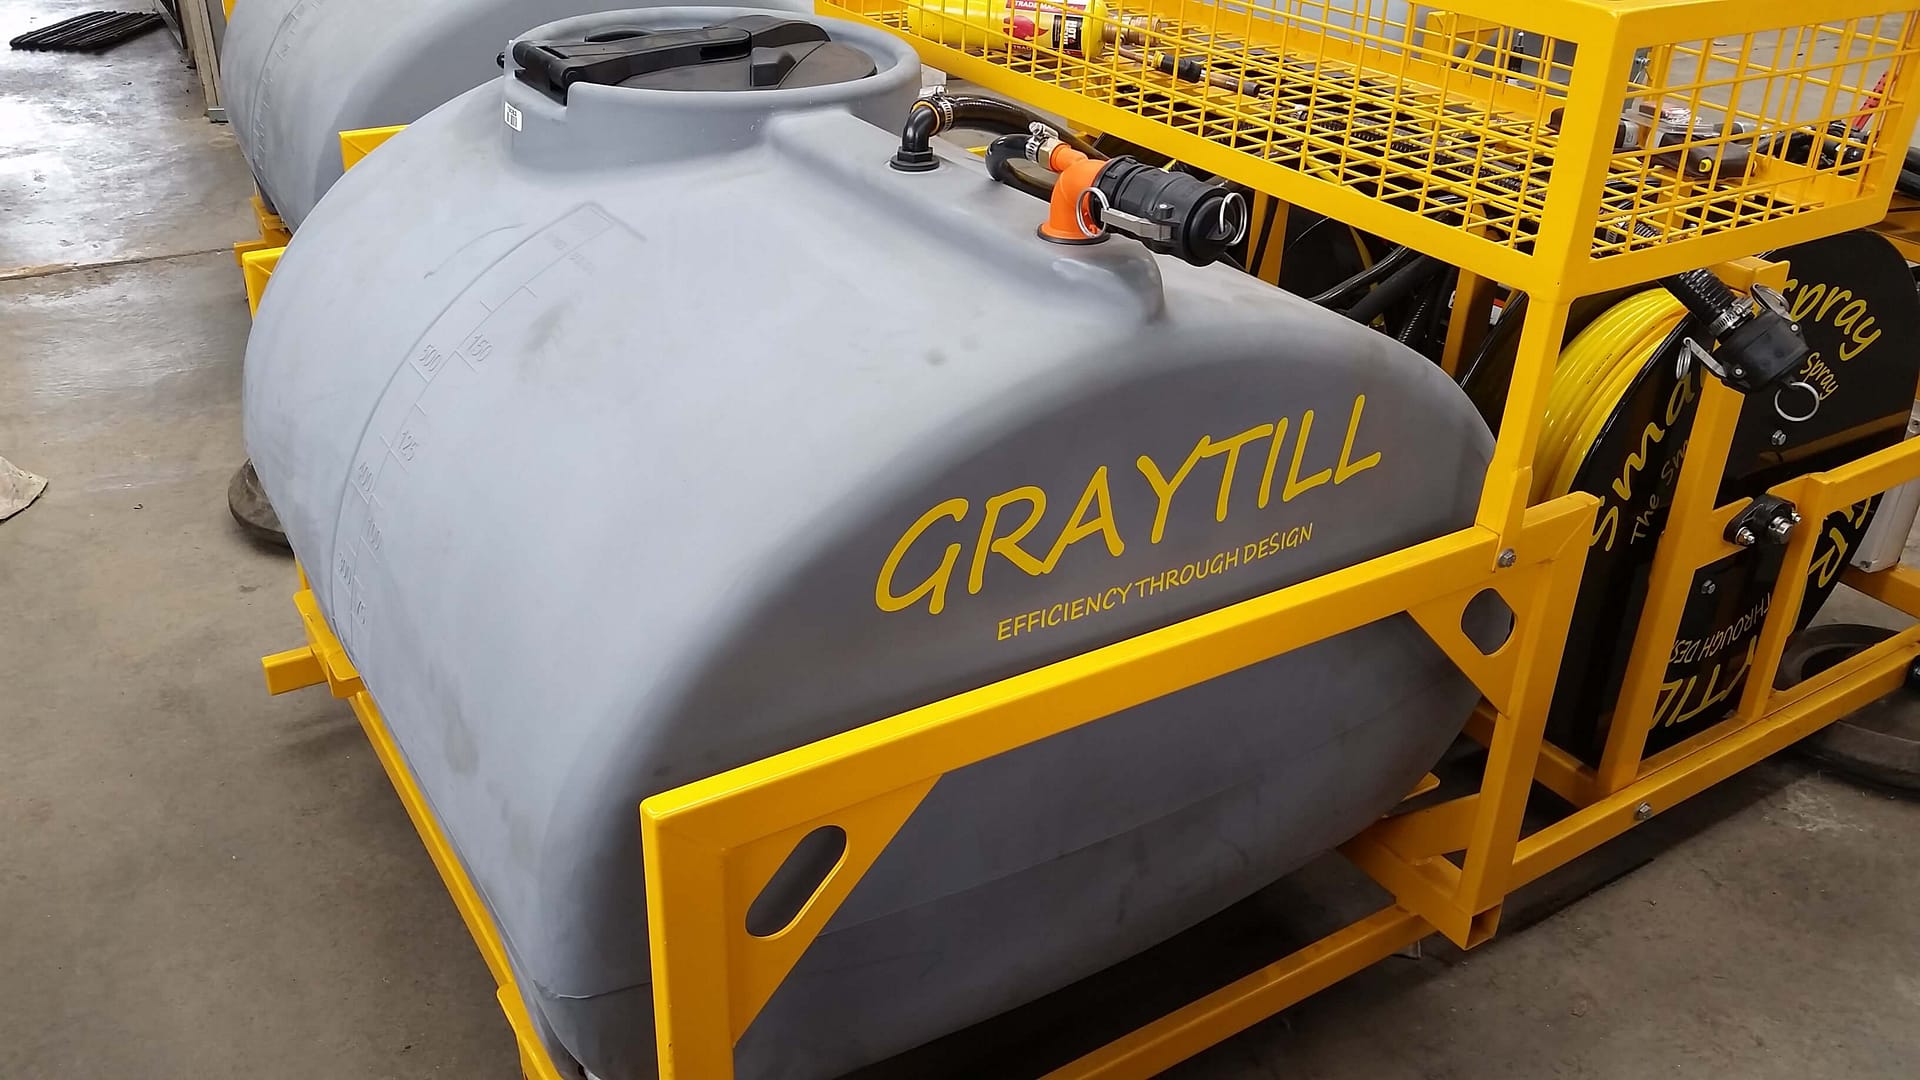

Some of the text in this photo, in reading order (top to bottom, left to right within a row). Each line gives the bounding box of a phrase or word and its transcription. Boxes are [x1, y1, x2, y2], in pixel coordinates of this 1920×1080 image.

[1783, 279, 1882, 361] pray
[1800, 351, 1839, 401] Spray
[1590, 371, 1696, 552] Sma
[874, 394, 1382, 614] GRAYTILL
[1630, 493, 1661, 545] The
[997, 521, 1314, 641] EFFICIENCY THROUGH DESIGN
[1669, 639, 1701, 664] DES
